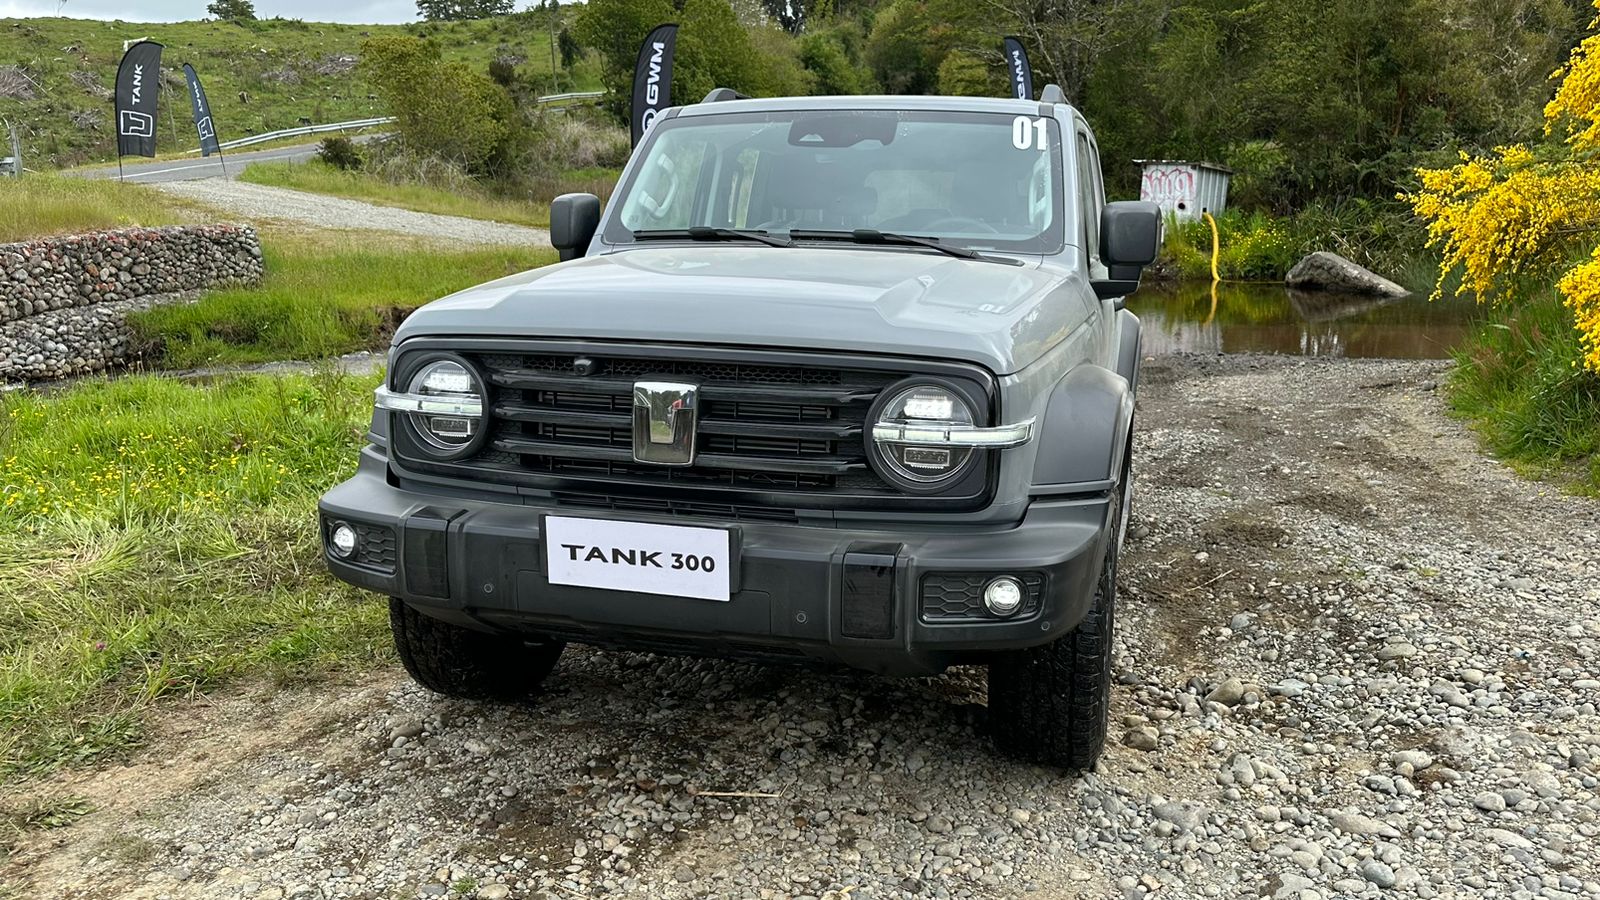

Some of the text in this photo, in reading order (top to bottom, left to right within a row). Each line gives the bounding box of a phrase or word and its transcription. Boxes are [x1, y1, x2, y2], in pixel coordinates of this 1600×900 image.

[132, 63, 143, 105] TANK
[646, 42, 665, 105] GWM
[1012, 116, 1047, 150] 01
[561, 544, 715, 572] TANK 300
